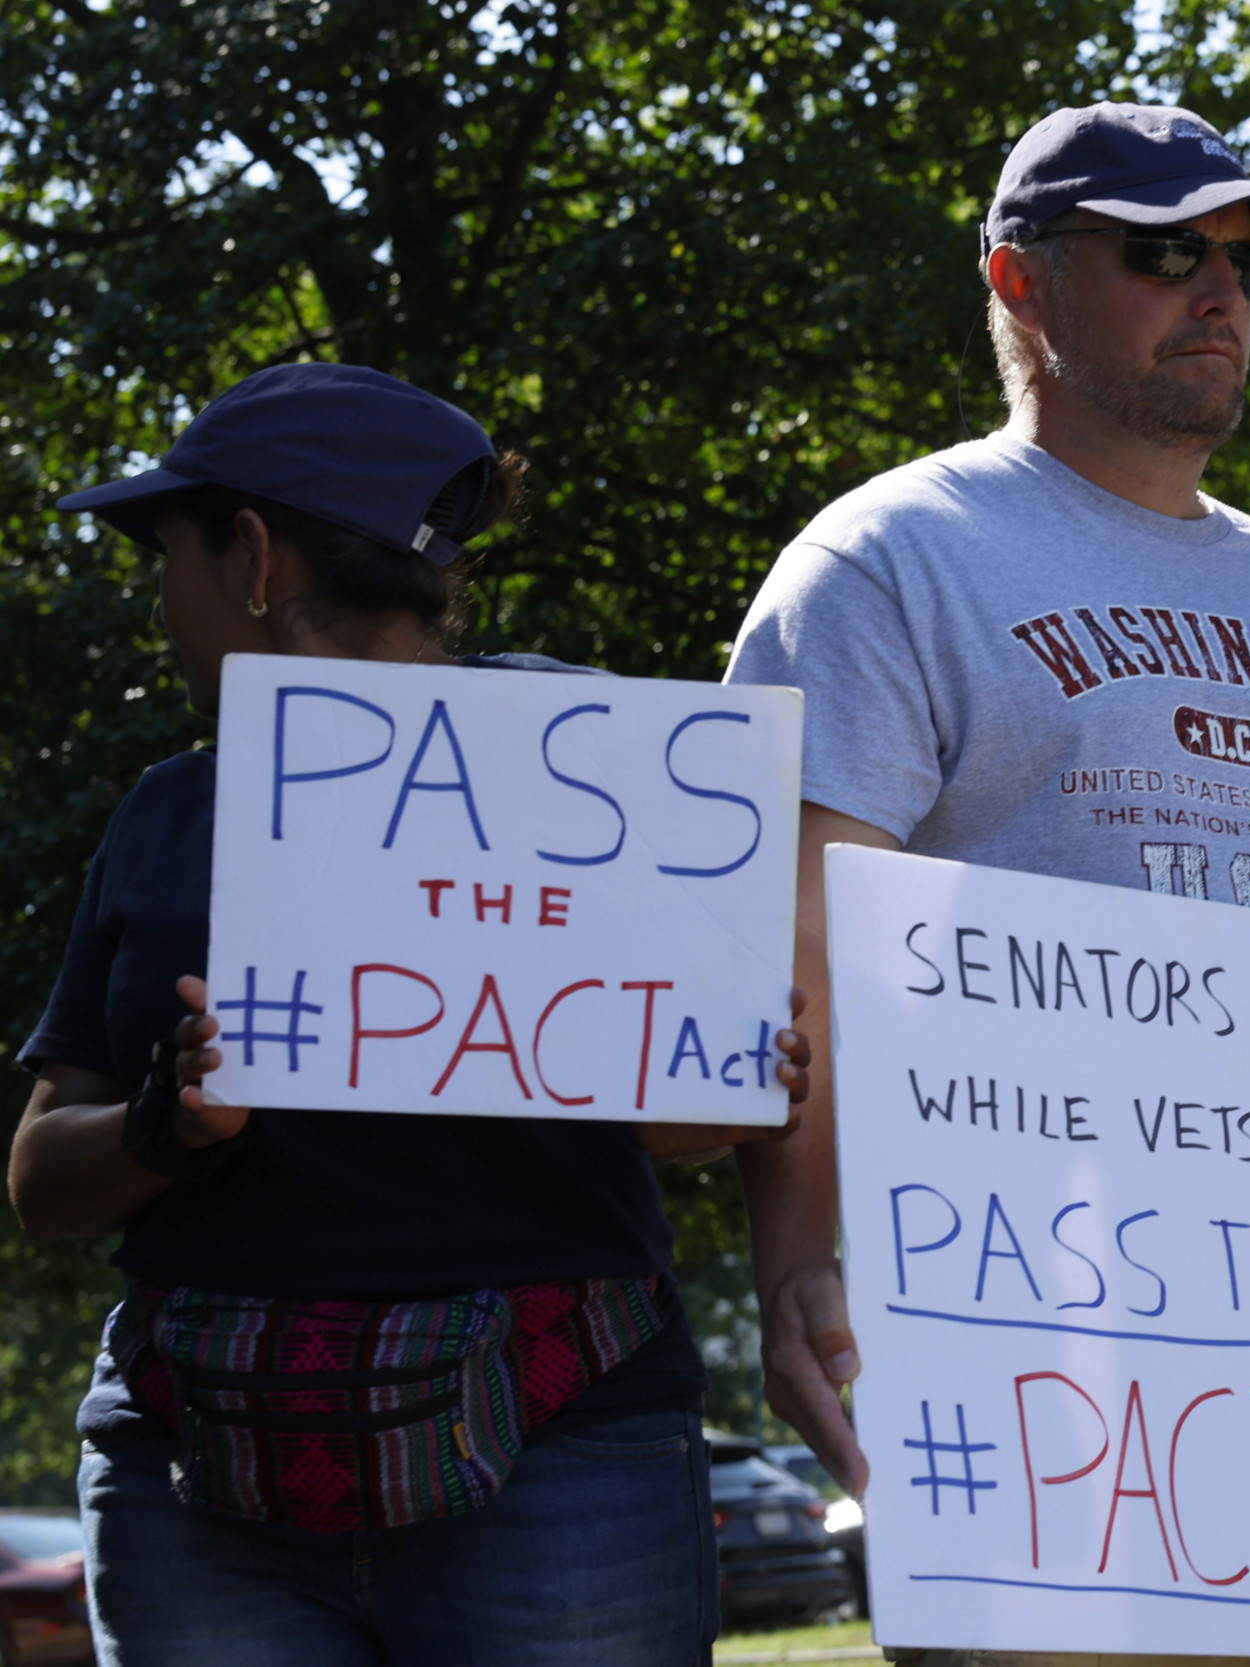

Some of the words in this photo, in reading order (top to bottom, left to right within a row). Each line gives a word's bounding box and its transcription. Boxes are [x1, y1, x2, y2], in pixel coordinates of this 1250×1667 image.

[271, 686, 762, 878] PASS
[1060, 769, 1163, 794] UNITED
[1090, 807, 1145, 826] THE
[419, 879, 571, 927] THE
[906, 923, 1235, 1037] SENATORS
[667, 1016, 773, 1089] Act
[908, 1069, 1099, 1141] WHILE
[889, 1184, 1166, 1316] PASS
